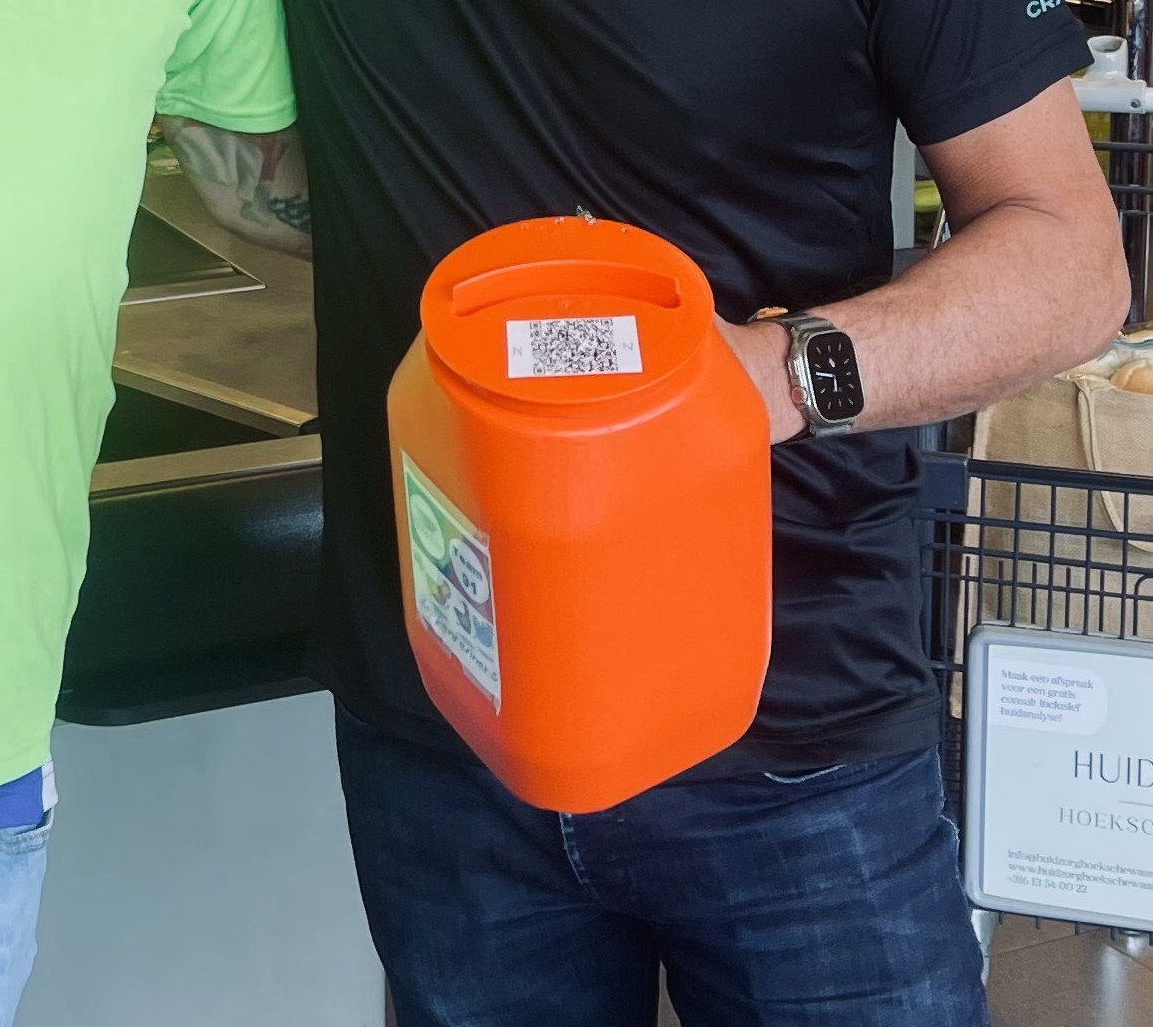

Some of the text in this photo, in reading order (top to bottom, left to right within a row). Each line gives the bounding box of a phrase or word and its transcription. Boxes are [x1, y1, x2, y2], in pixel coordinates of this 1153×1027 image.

[1001, 669, 1094, 689] Maak een afspraak
[1001, 683, 1076, 699] voor een gratis
[1000, 696, 1036, 707] consult
[1076, 883, 1087, 893] 22
